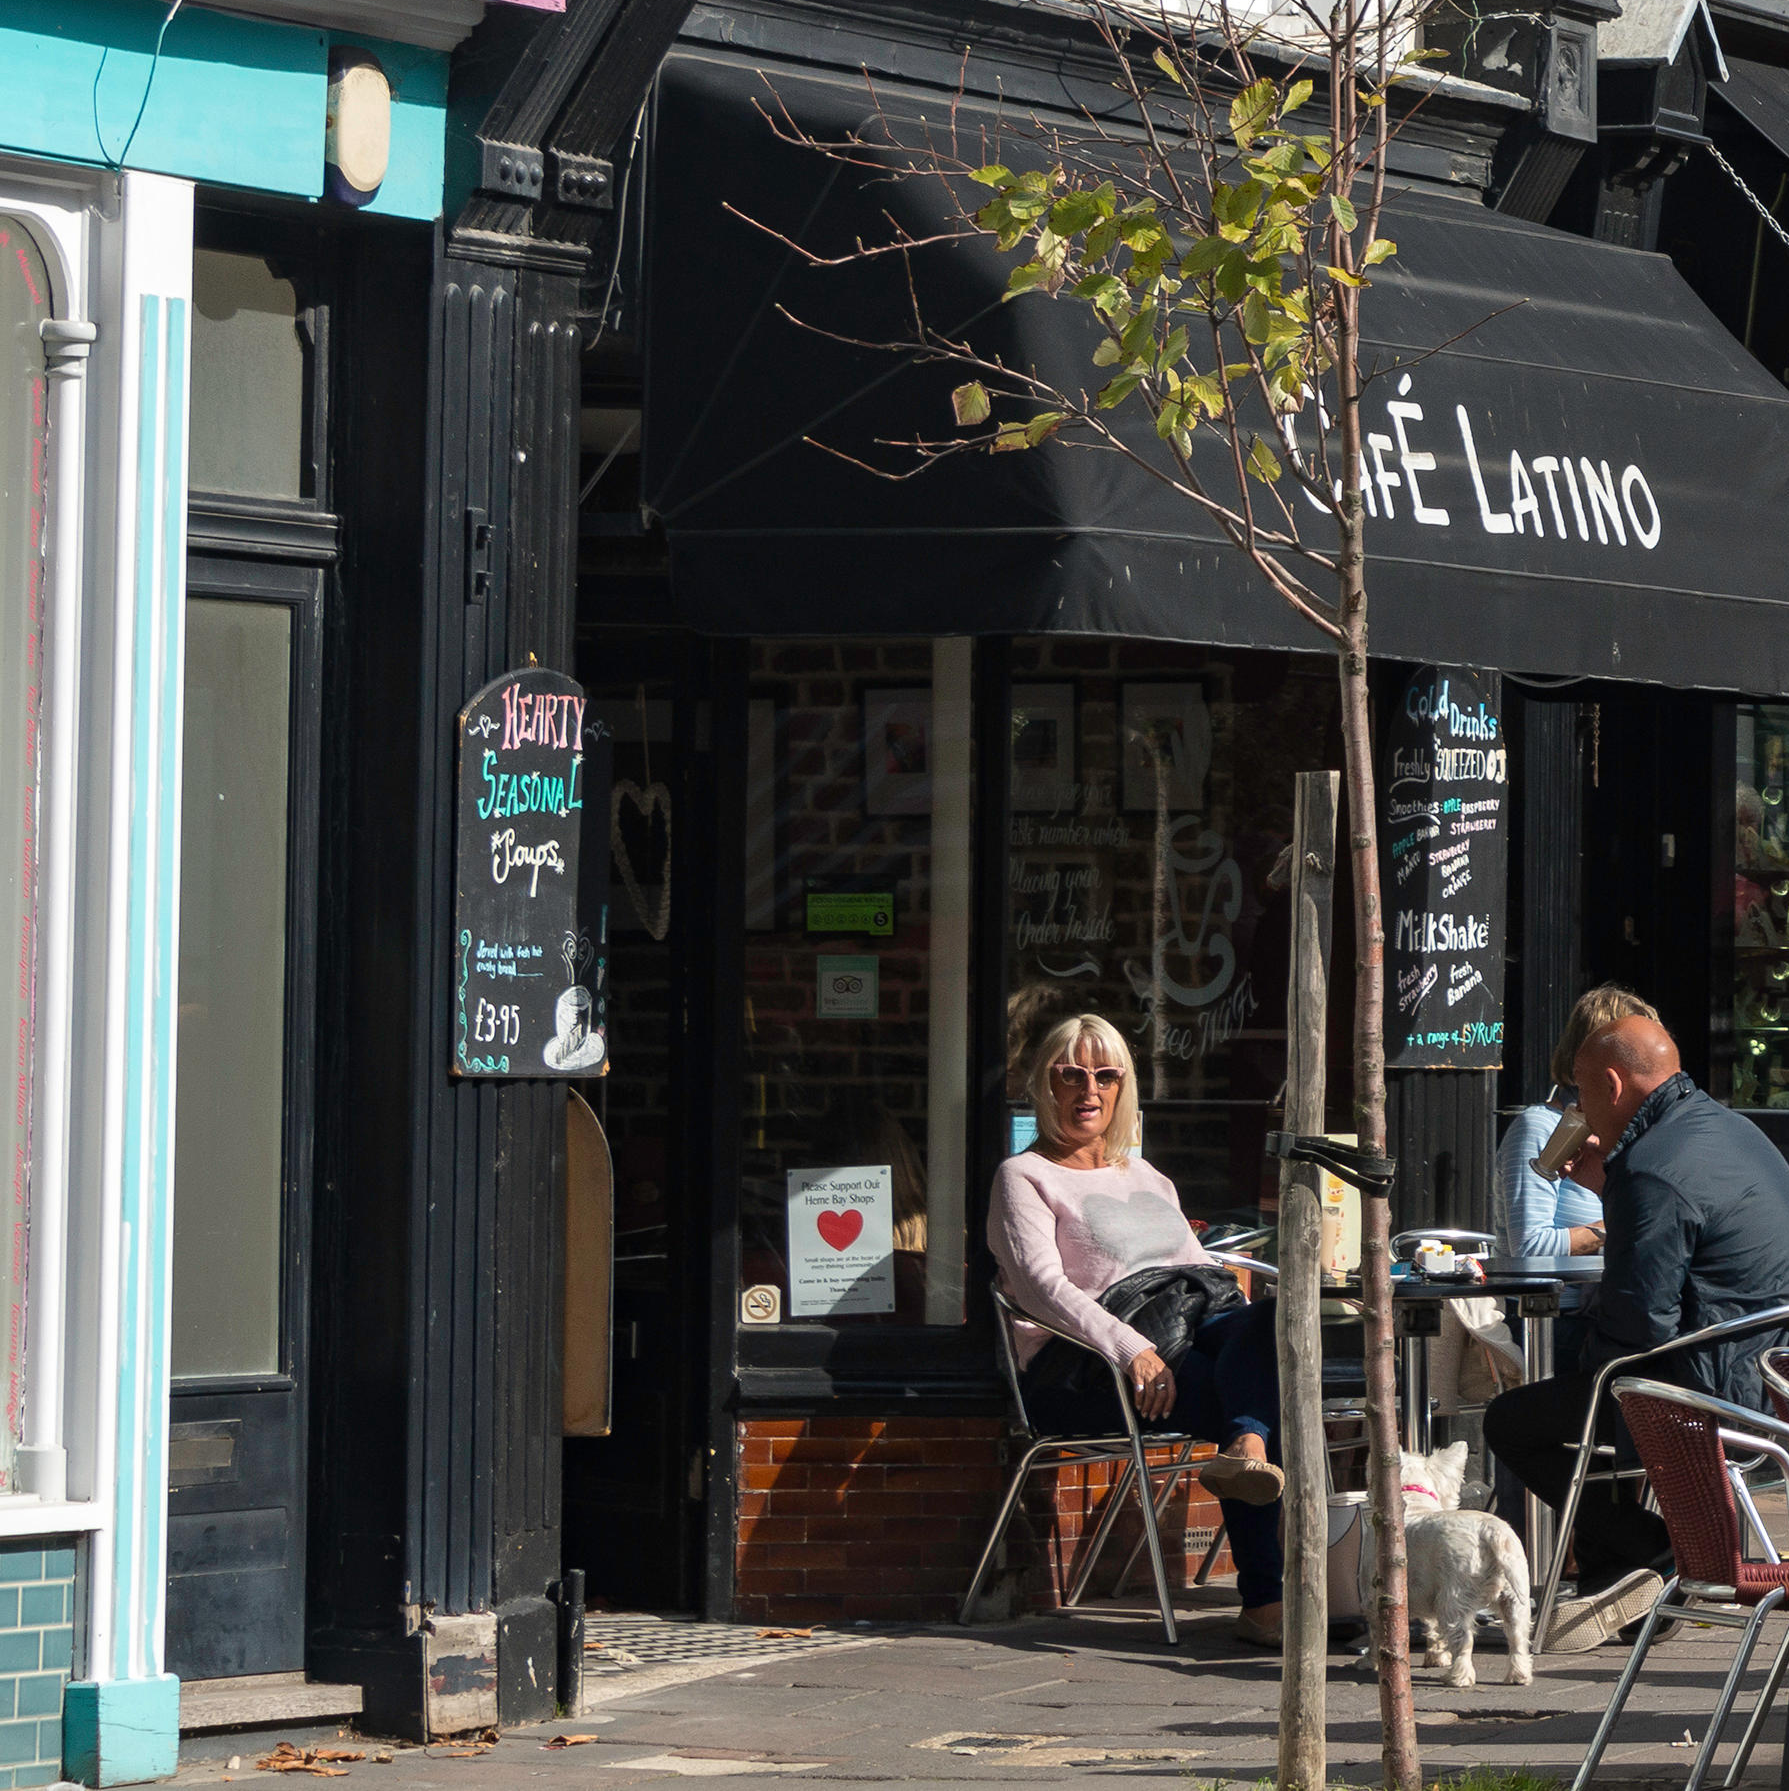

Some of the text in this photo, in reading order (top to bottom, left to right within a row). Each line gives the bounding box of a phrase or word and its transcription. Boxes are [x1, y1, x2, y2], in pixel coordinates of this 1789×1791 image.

[30, 507, 41, 548] Zara
[28, 561, 40, 622] Chanel
[27, 633, 37, 668] Kew
[27, 686, 37, 714] Ted
[501, 683, 588, 752] HEARTY
[1450, 703, 1498, 741] Drinks
[25, 720, 35, 770] Baker
[1435, 747, 1486, 782] SQUEEZED
[477, 753, 583, 821] SEASONAL
[1461, 799, 1500, 815] RASPBERRY
[23, 786, 34, 831] Louis
[1450, 818, 1498, 836] STRAWBERRY
[22, 838, 33, 899] Vuitton
[493, 828, 560, 898] Soups
[1442, 869, 1473, 899] ORANGE
[1446, 969, 1483, 1007] Banana
[1450, 960, 1474, 984] fresh
[18, 1018, 28, 1067] Karen
[1464, 1022, 1504, 1048] SYRUPS
[16, 1072, 27, 1126] Millen
[13, 1144, 24, 1206] Joseph
[802, 1179, 881, 1193] Please Support Our
[832, 1194, 847, 1207] Bay
[849, 1194, 875, 1206] Shops
[12, 1222, 23, 1285] Versace
[9, 1304, 21, 1364] Tommy
